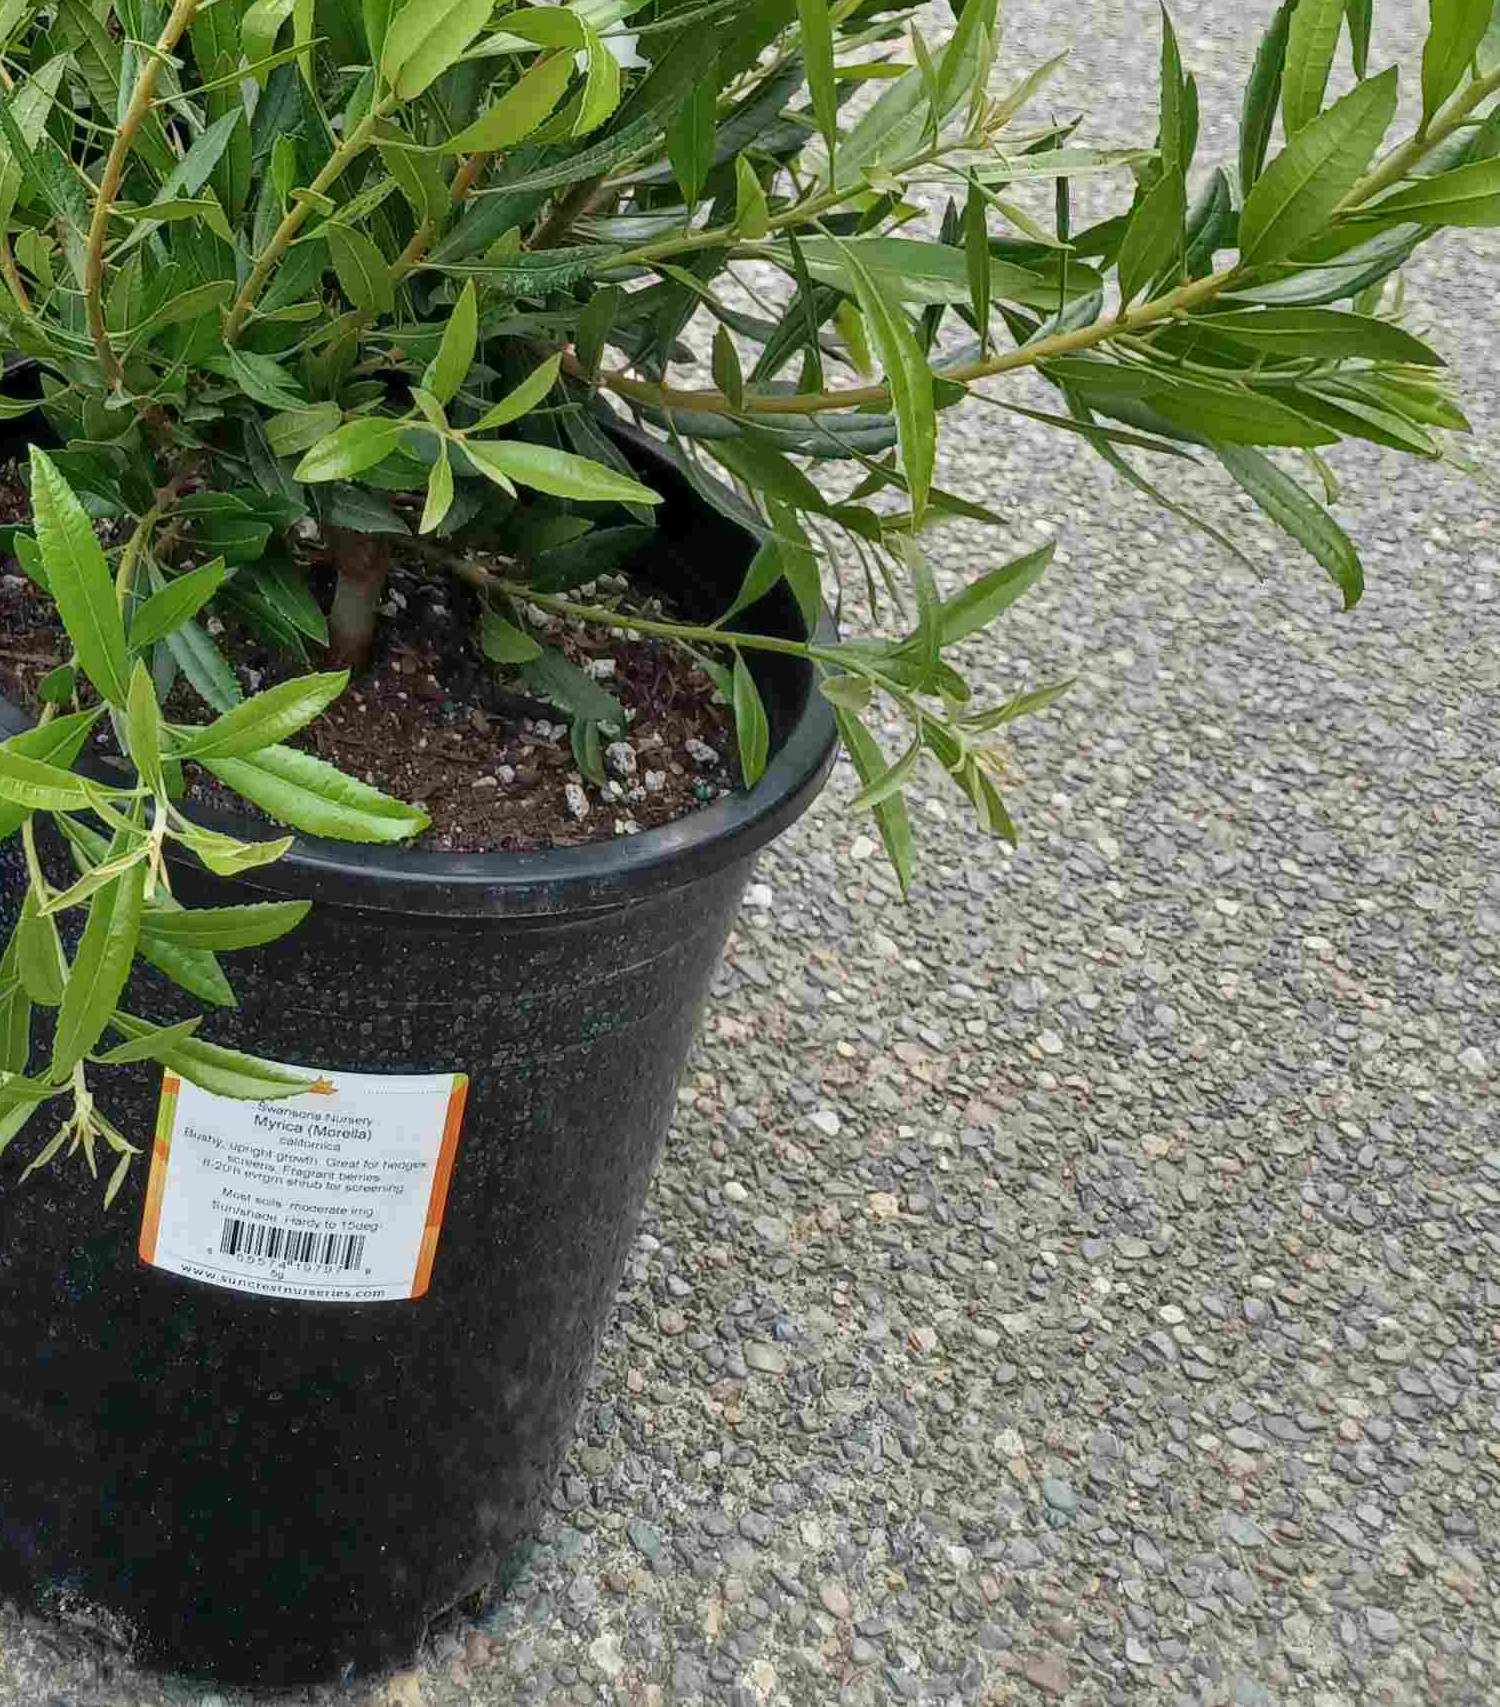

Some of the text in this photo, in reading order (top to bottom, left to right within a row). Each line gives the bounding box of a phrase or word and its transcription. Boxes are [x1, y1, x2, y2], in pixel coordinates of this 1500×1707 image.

[258, 1100, 373, 1127] Swansons Nursery
[253, 1114, 373, 1142] Myrica (Morella)
[229, 1143, 273, 1159] upright
[325, 1157, 360, 1170] Great
[363, 1159, 379, 1170] for
[280, 1136, 341, 1151] californica
[282, 1164, 336, 1180] Fragrant
[286, 1177, 323, 1190] shrub
[326, 1181, 341, 1191] for
[346, 1184, 404, 1195] screening
[221, 1187, 252, 1201] Most
[289, 1202, 348, 1214] moderate
[283, 1214, 319, 1229] Hardy
[324, 1221, 337, 1230] to
[180, 1262, 386, 1297] www.suncrestnurseries.com
